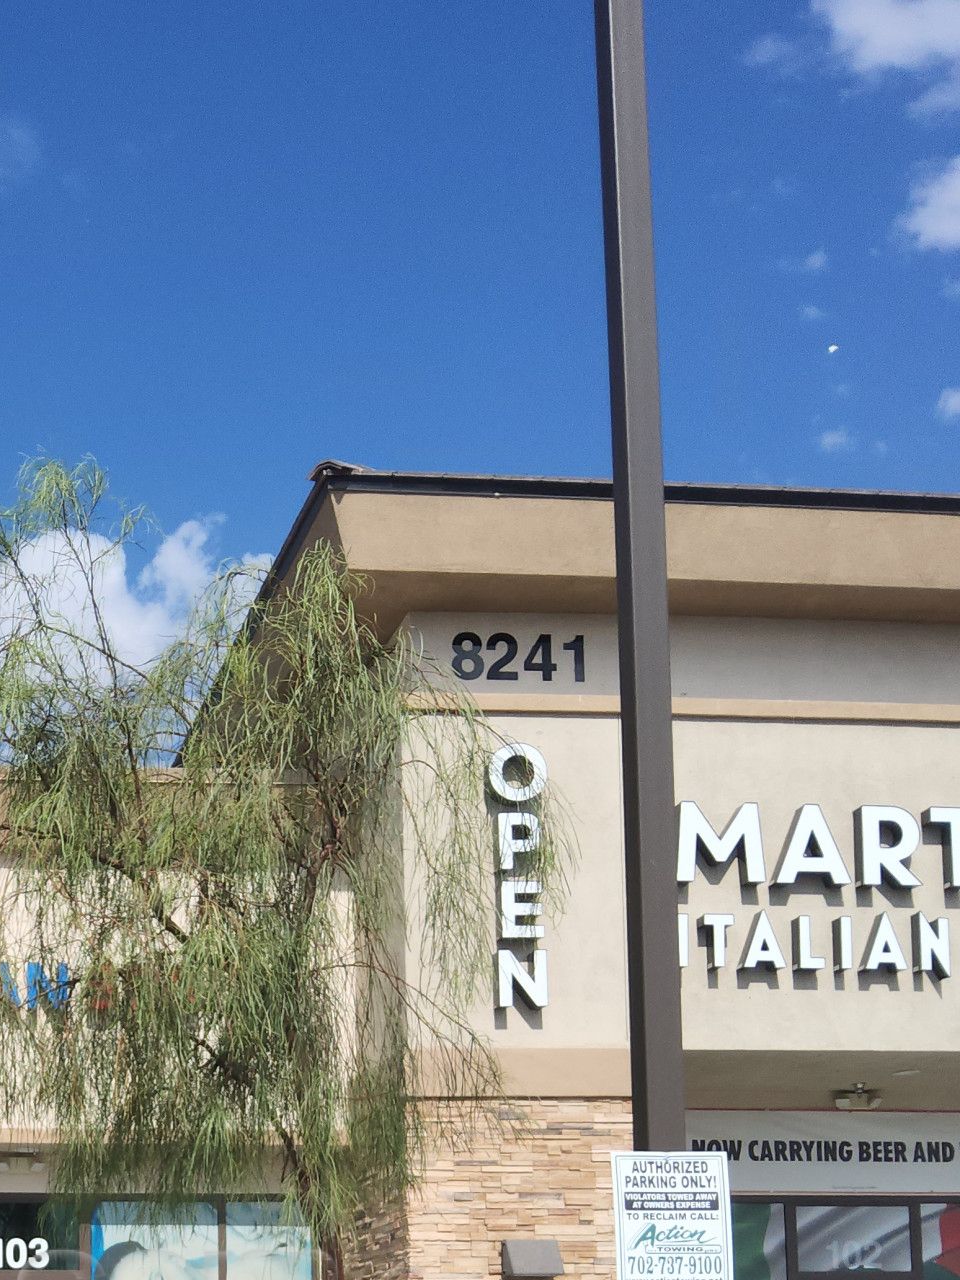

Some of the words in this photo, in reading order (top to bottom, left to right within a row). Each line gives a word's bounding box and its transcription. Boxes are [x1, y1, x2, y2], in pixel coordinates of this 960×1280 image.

[451, 632, 586, 682] 8241
[488, 743, 548, 1008] OPEN
[678, 910, 951, 979] ITALIAN
[748, 1140, 853, 1162] CARRYING
[858, 1141, 908, 1163] BEER
[913, 1141, 955, 1163] AND
[632, 1161, 708, 1173] AUTHORIZED
[625, 1176, 677, 1188] PARKING
[681, 1176, 717, 1188] ONLY!
[632, 1201, 642, 1209] AT
[643, 1201, 674, 1209] OWNERS
[676, 1201, 711, 1209] EXPENSE
[667, 1193, 694, 1201] TOWED
[627, 1212, 640, 1221] TO
[642, 1212, 687, 1221] RECLAIM
[690, 1212, 719, 1221] CALL:
[630, 1222, 709, 1250] Action
[627, 1255, 722, 1275] 702-737-9100
